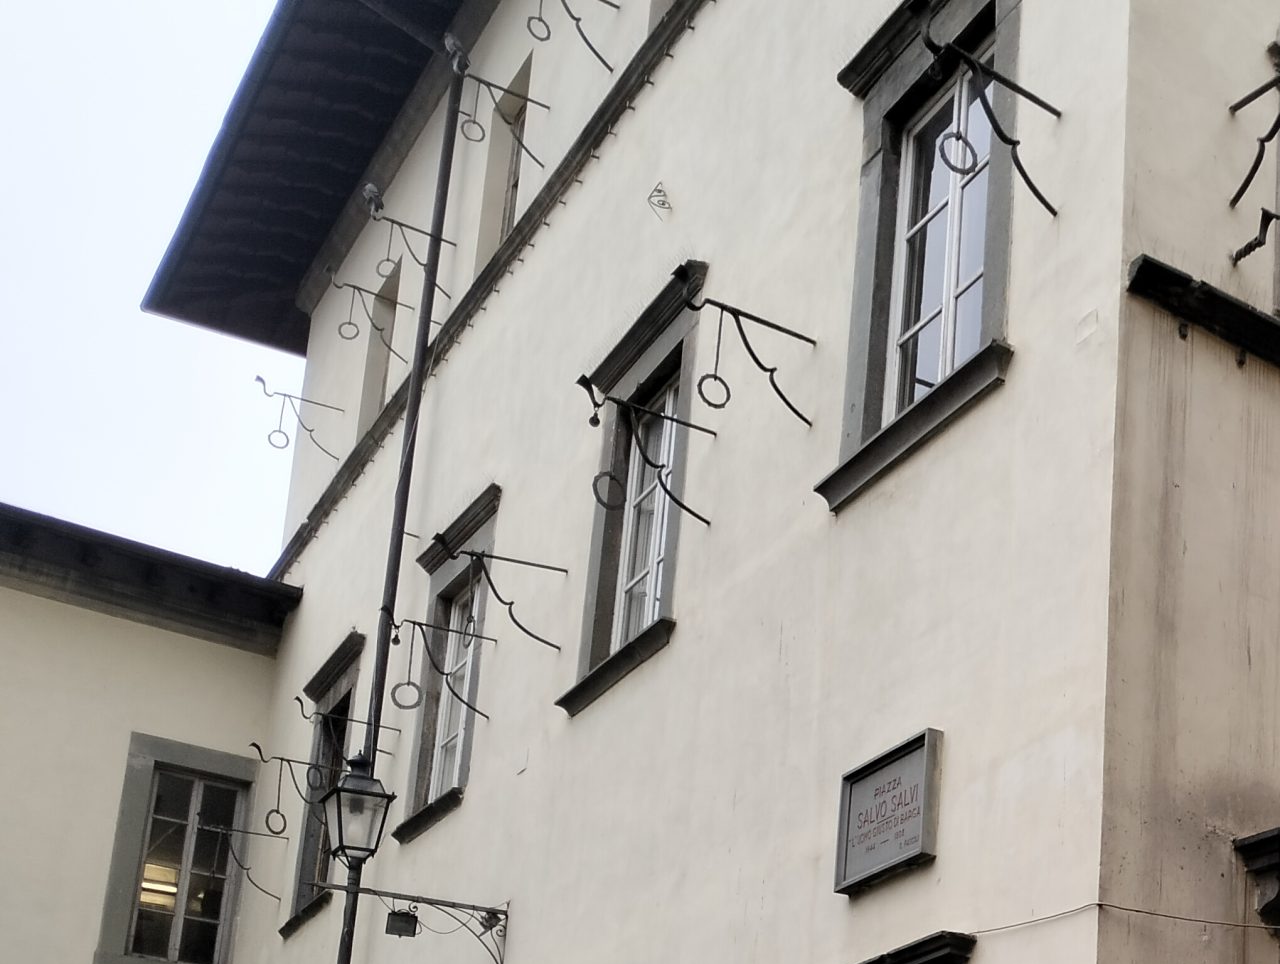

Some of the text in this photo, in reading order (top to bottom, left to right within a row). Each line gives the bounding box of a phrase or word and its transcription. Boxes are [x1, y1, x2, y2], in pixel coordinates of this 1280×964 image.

[873, 776, 902, 799] PIAZZA
[856, 783, 919, 830] SALVO SALVI
